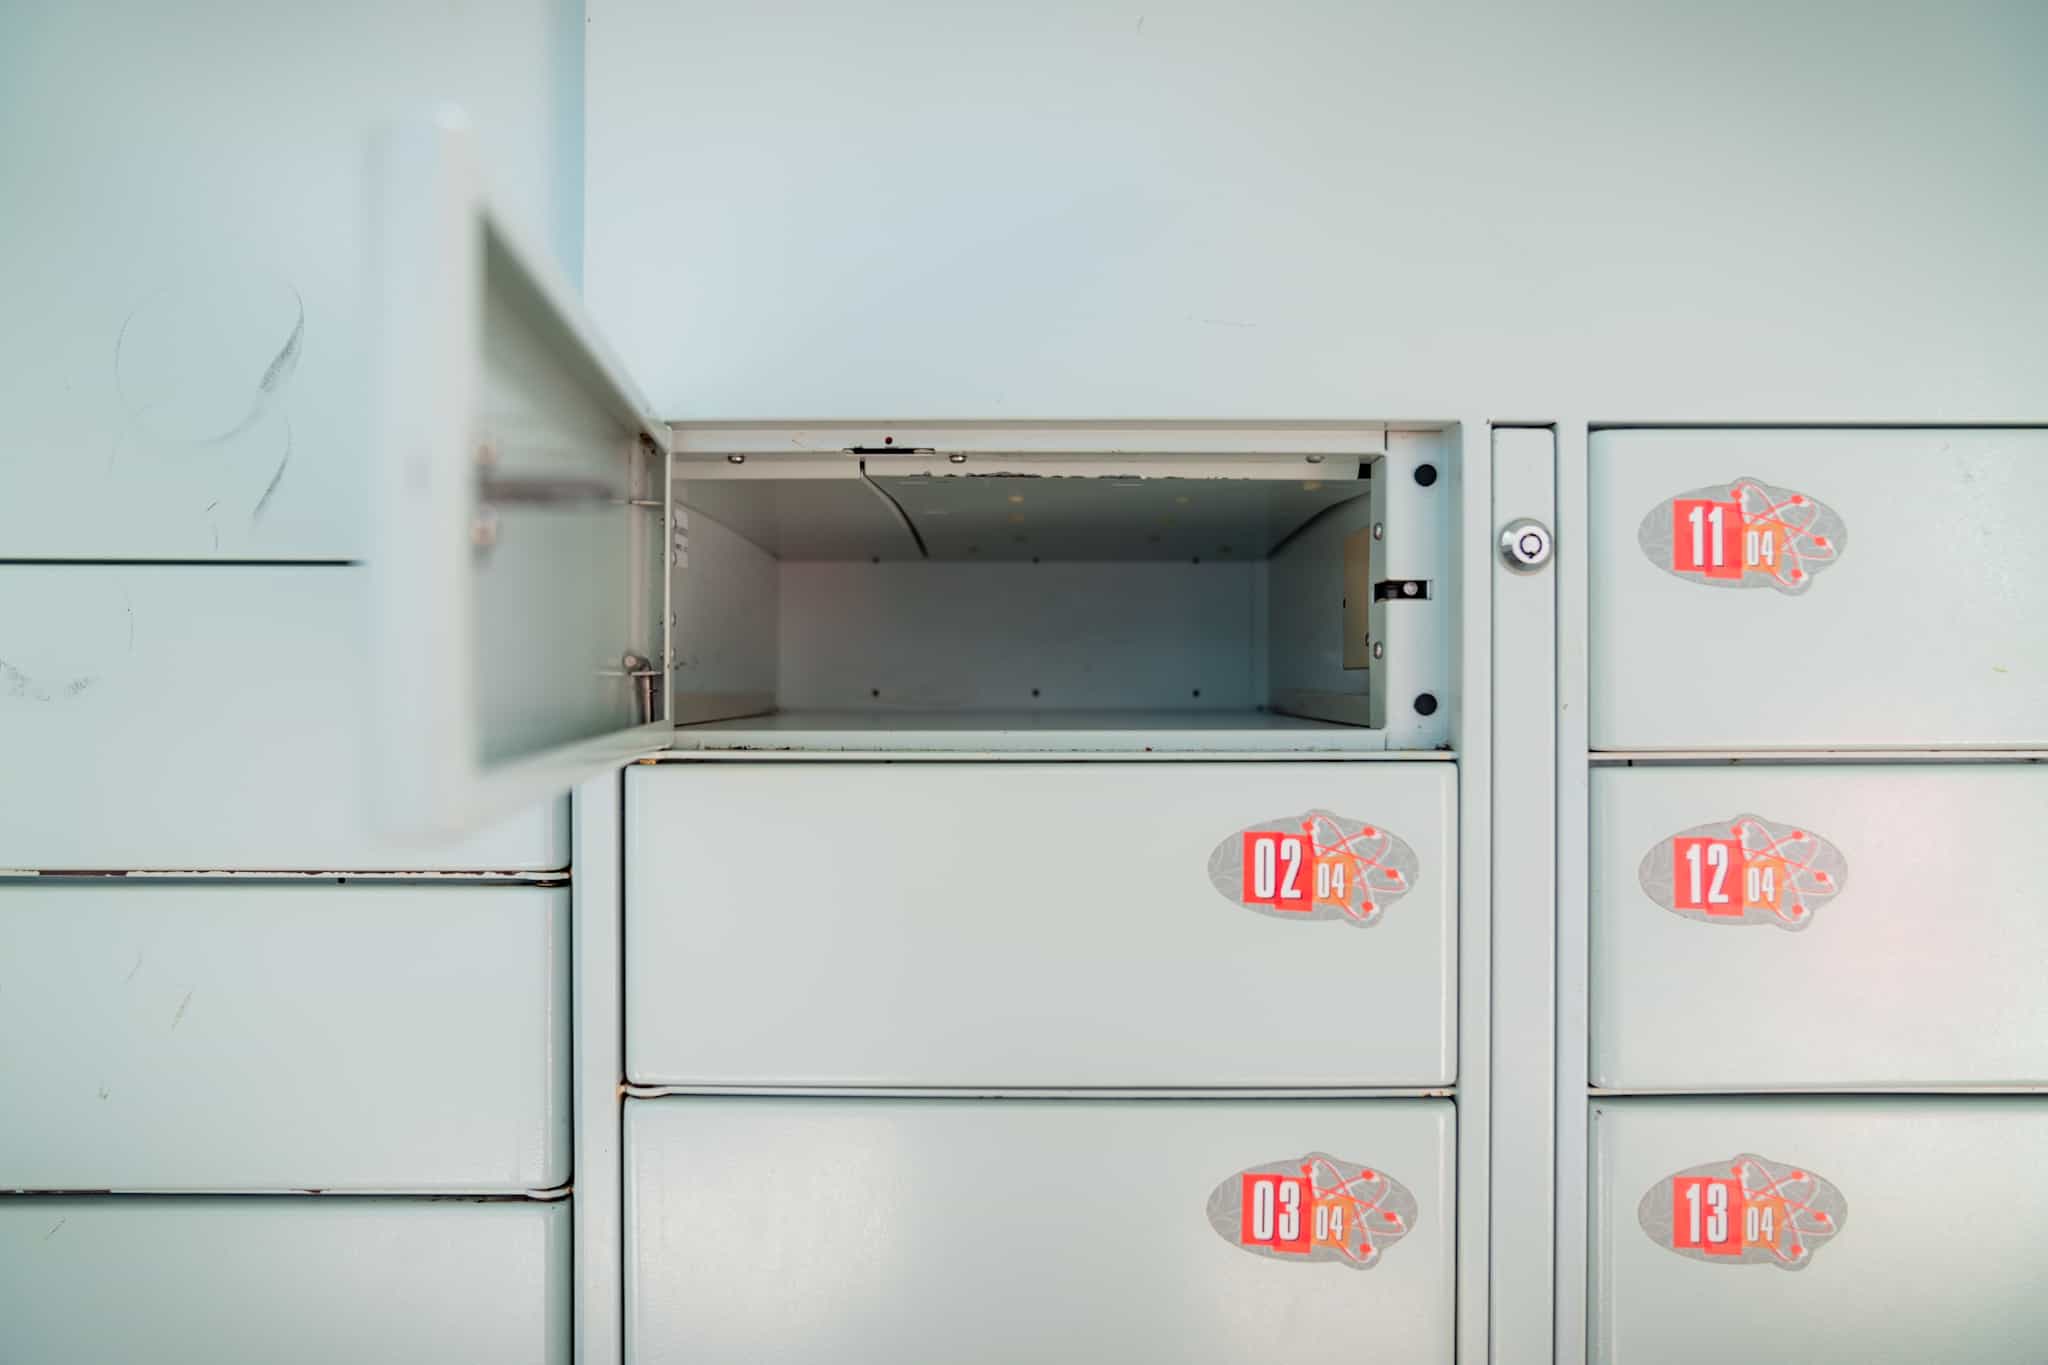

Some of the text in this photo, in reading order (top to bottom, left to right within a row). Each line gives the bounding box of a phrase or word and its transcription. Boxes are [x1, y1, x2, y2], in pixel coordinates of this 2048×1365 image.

[1689, 506, 1774, 566] 11 04
[1255, 838, 1345, 898] 02 04
[1686, 843, 1775, 903] 12 04
[1253, 1181, 1343, 1240] 03 04
[1686, 1183, 1773, 1242] 13 04
